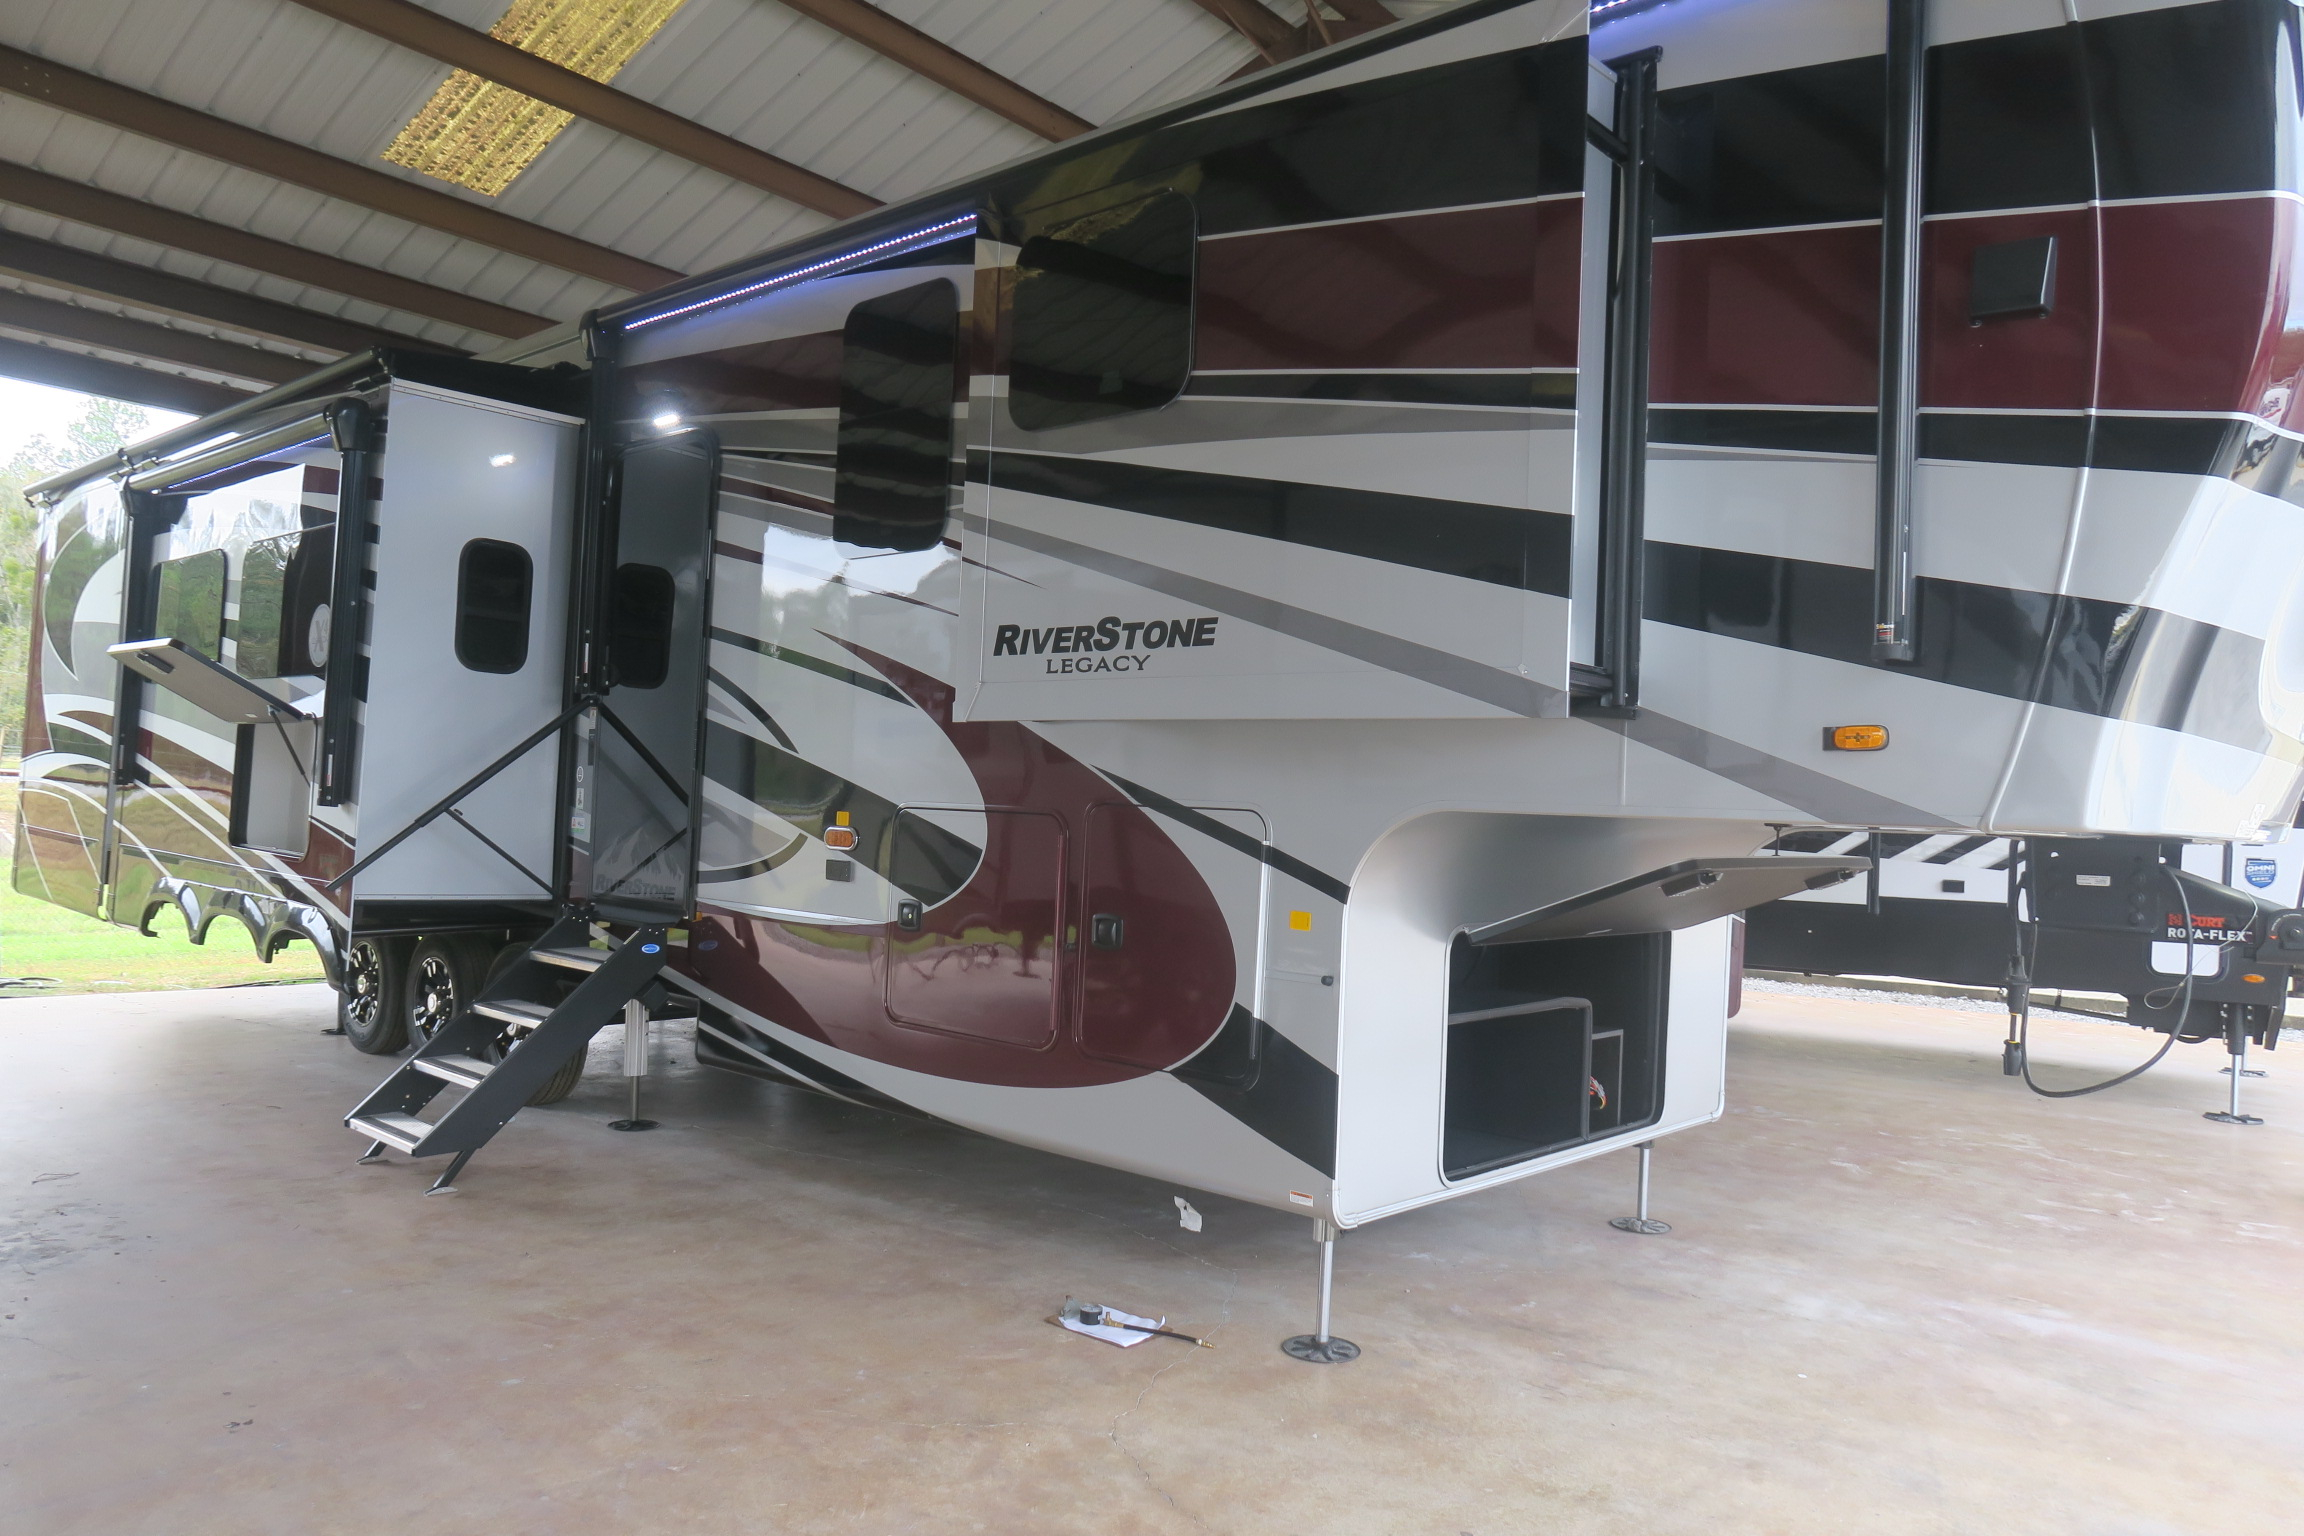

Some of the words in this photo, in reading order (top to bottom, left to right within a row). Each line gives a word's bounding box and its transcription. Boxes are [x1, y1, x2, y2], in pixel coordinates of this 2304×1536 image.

[993, 616, 1219, 657] RIVERSTONE
[1046, 655, 1151, 674] LEGACY
[2246, 864, 2275, 872] OMNI
